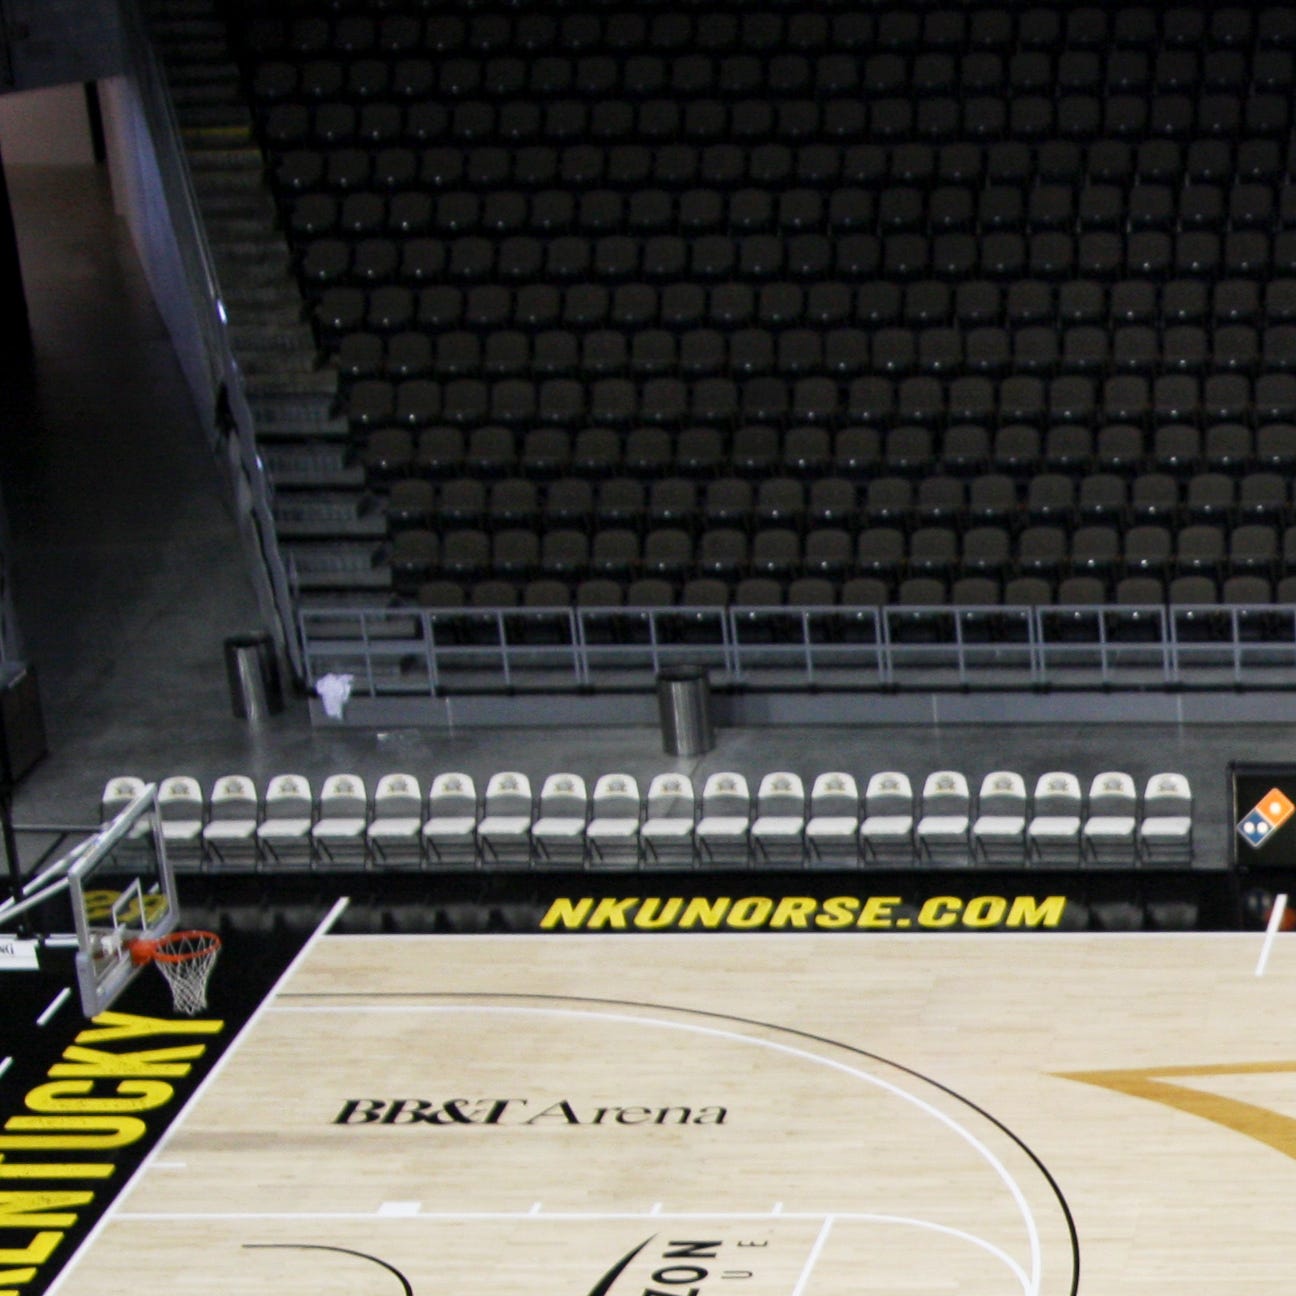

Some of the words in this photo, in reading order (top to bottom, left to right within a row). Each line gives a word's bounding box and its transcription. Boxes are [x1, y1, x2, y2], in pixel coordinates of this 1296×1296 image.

[539, 895, 1066, 930] NKUNORSE.COM
[331, 1098, 527, 1126] BB&T
[525, 1098, 729, 1126] Arena
